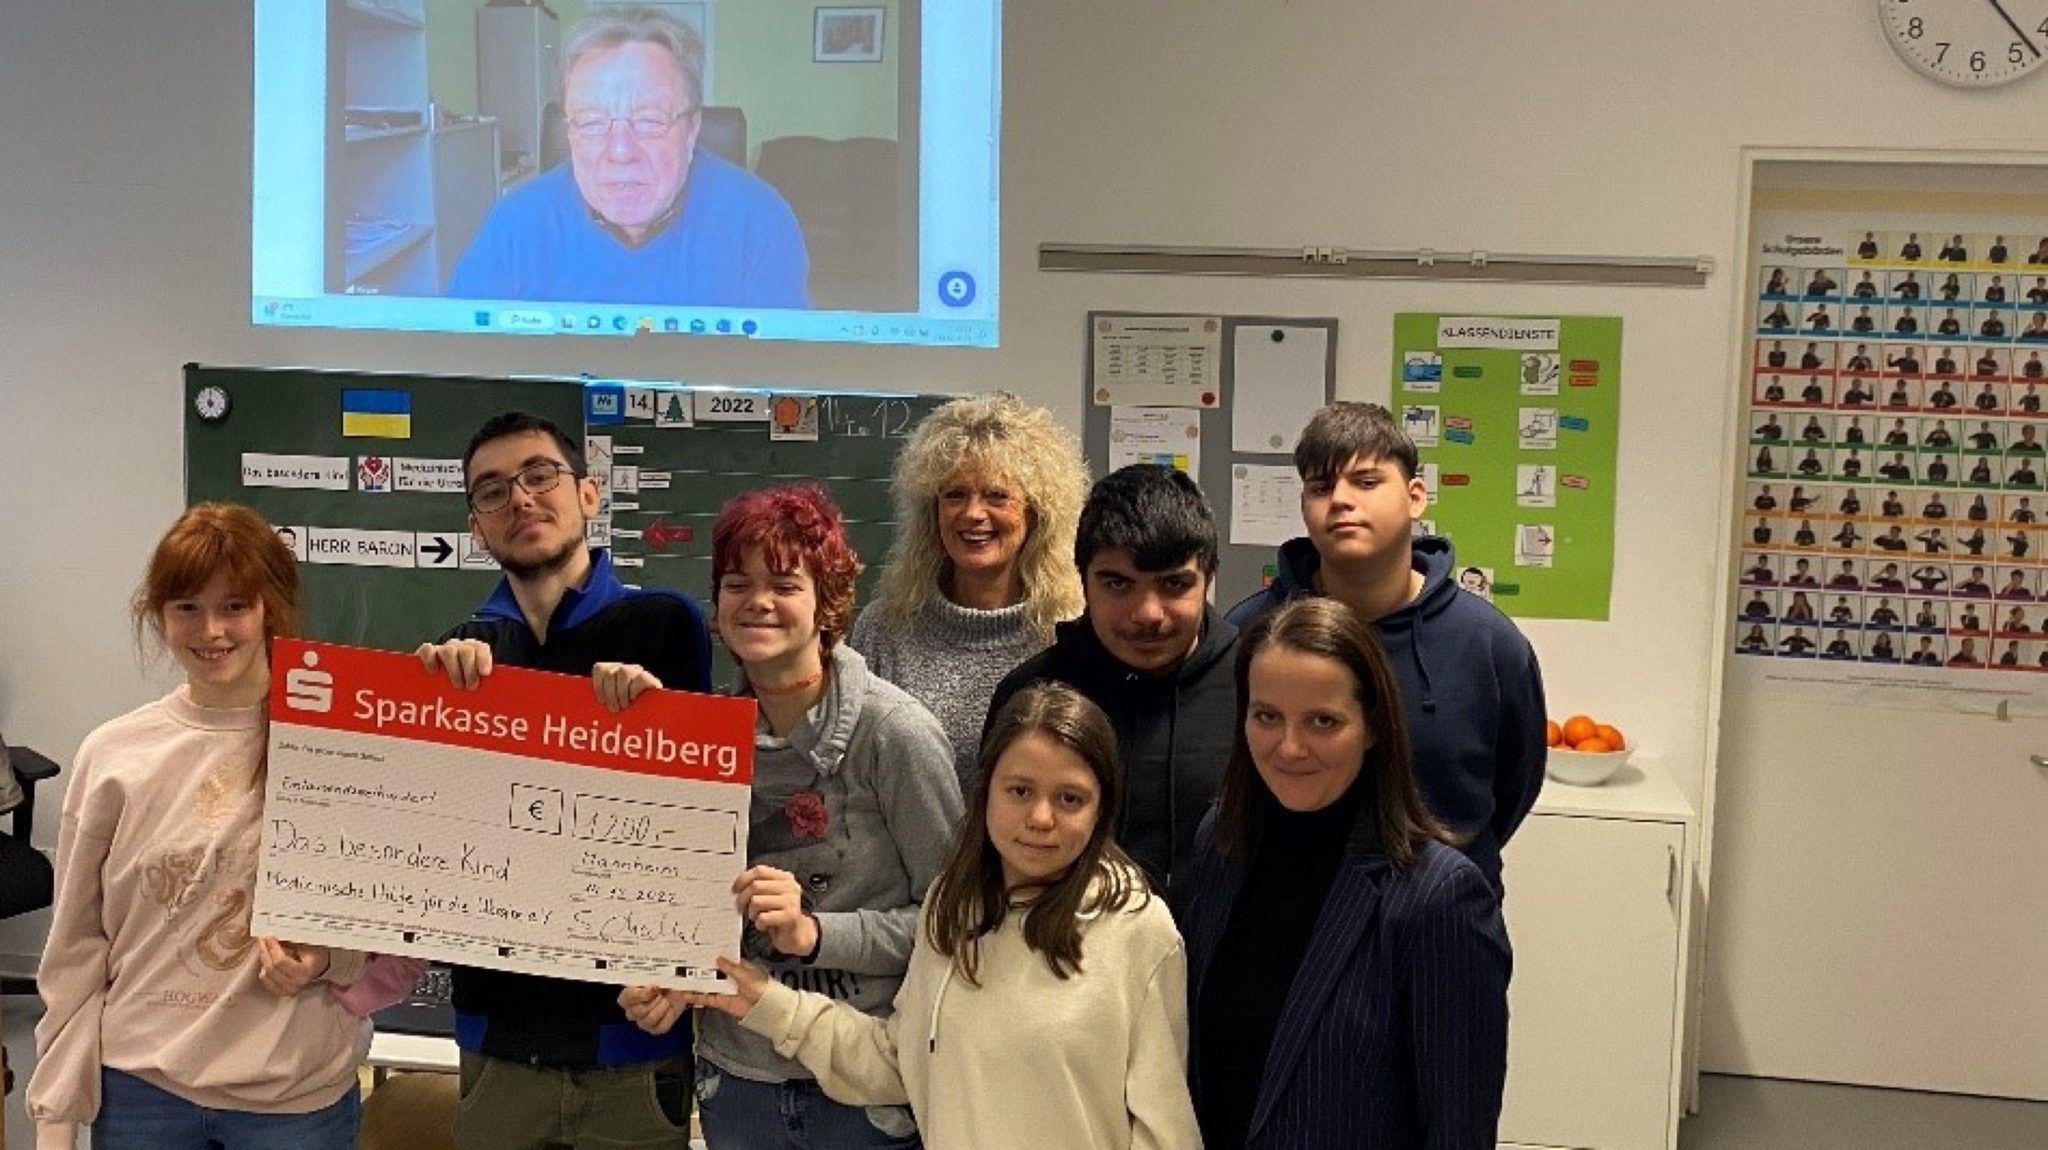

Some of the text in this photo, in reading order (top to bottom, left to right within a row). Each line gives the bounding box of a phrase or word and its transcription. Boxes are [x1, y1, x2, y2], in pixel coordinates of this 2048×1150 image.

[1907, 16, 1924, 39] 8
[2037, 16, 2048, 38] 4
[1935, 42, 1951, 64] 7
[1969, 51, 1986, 72] 6
[2008, 42, 2023, 63] 5
[1442, 327, 1555, 340] KLASSENDIENSTE
[710, 396, 755, 413] 2022
[310, 538, 413, 556] HERR BARON
[353, 689, 738, 777] Sparkasse Heidelberg
[527, 799, 545, 821] €
[269, 819, 512, 882] Das besondere Kind
[581, 851, 678, 877] Mannheim
